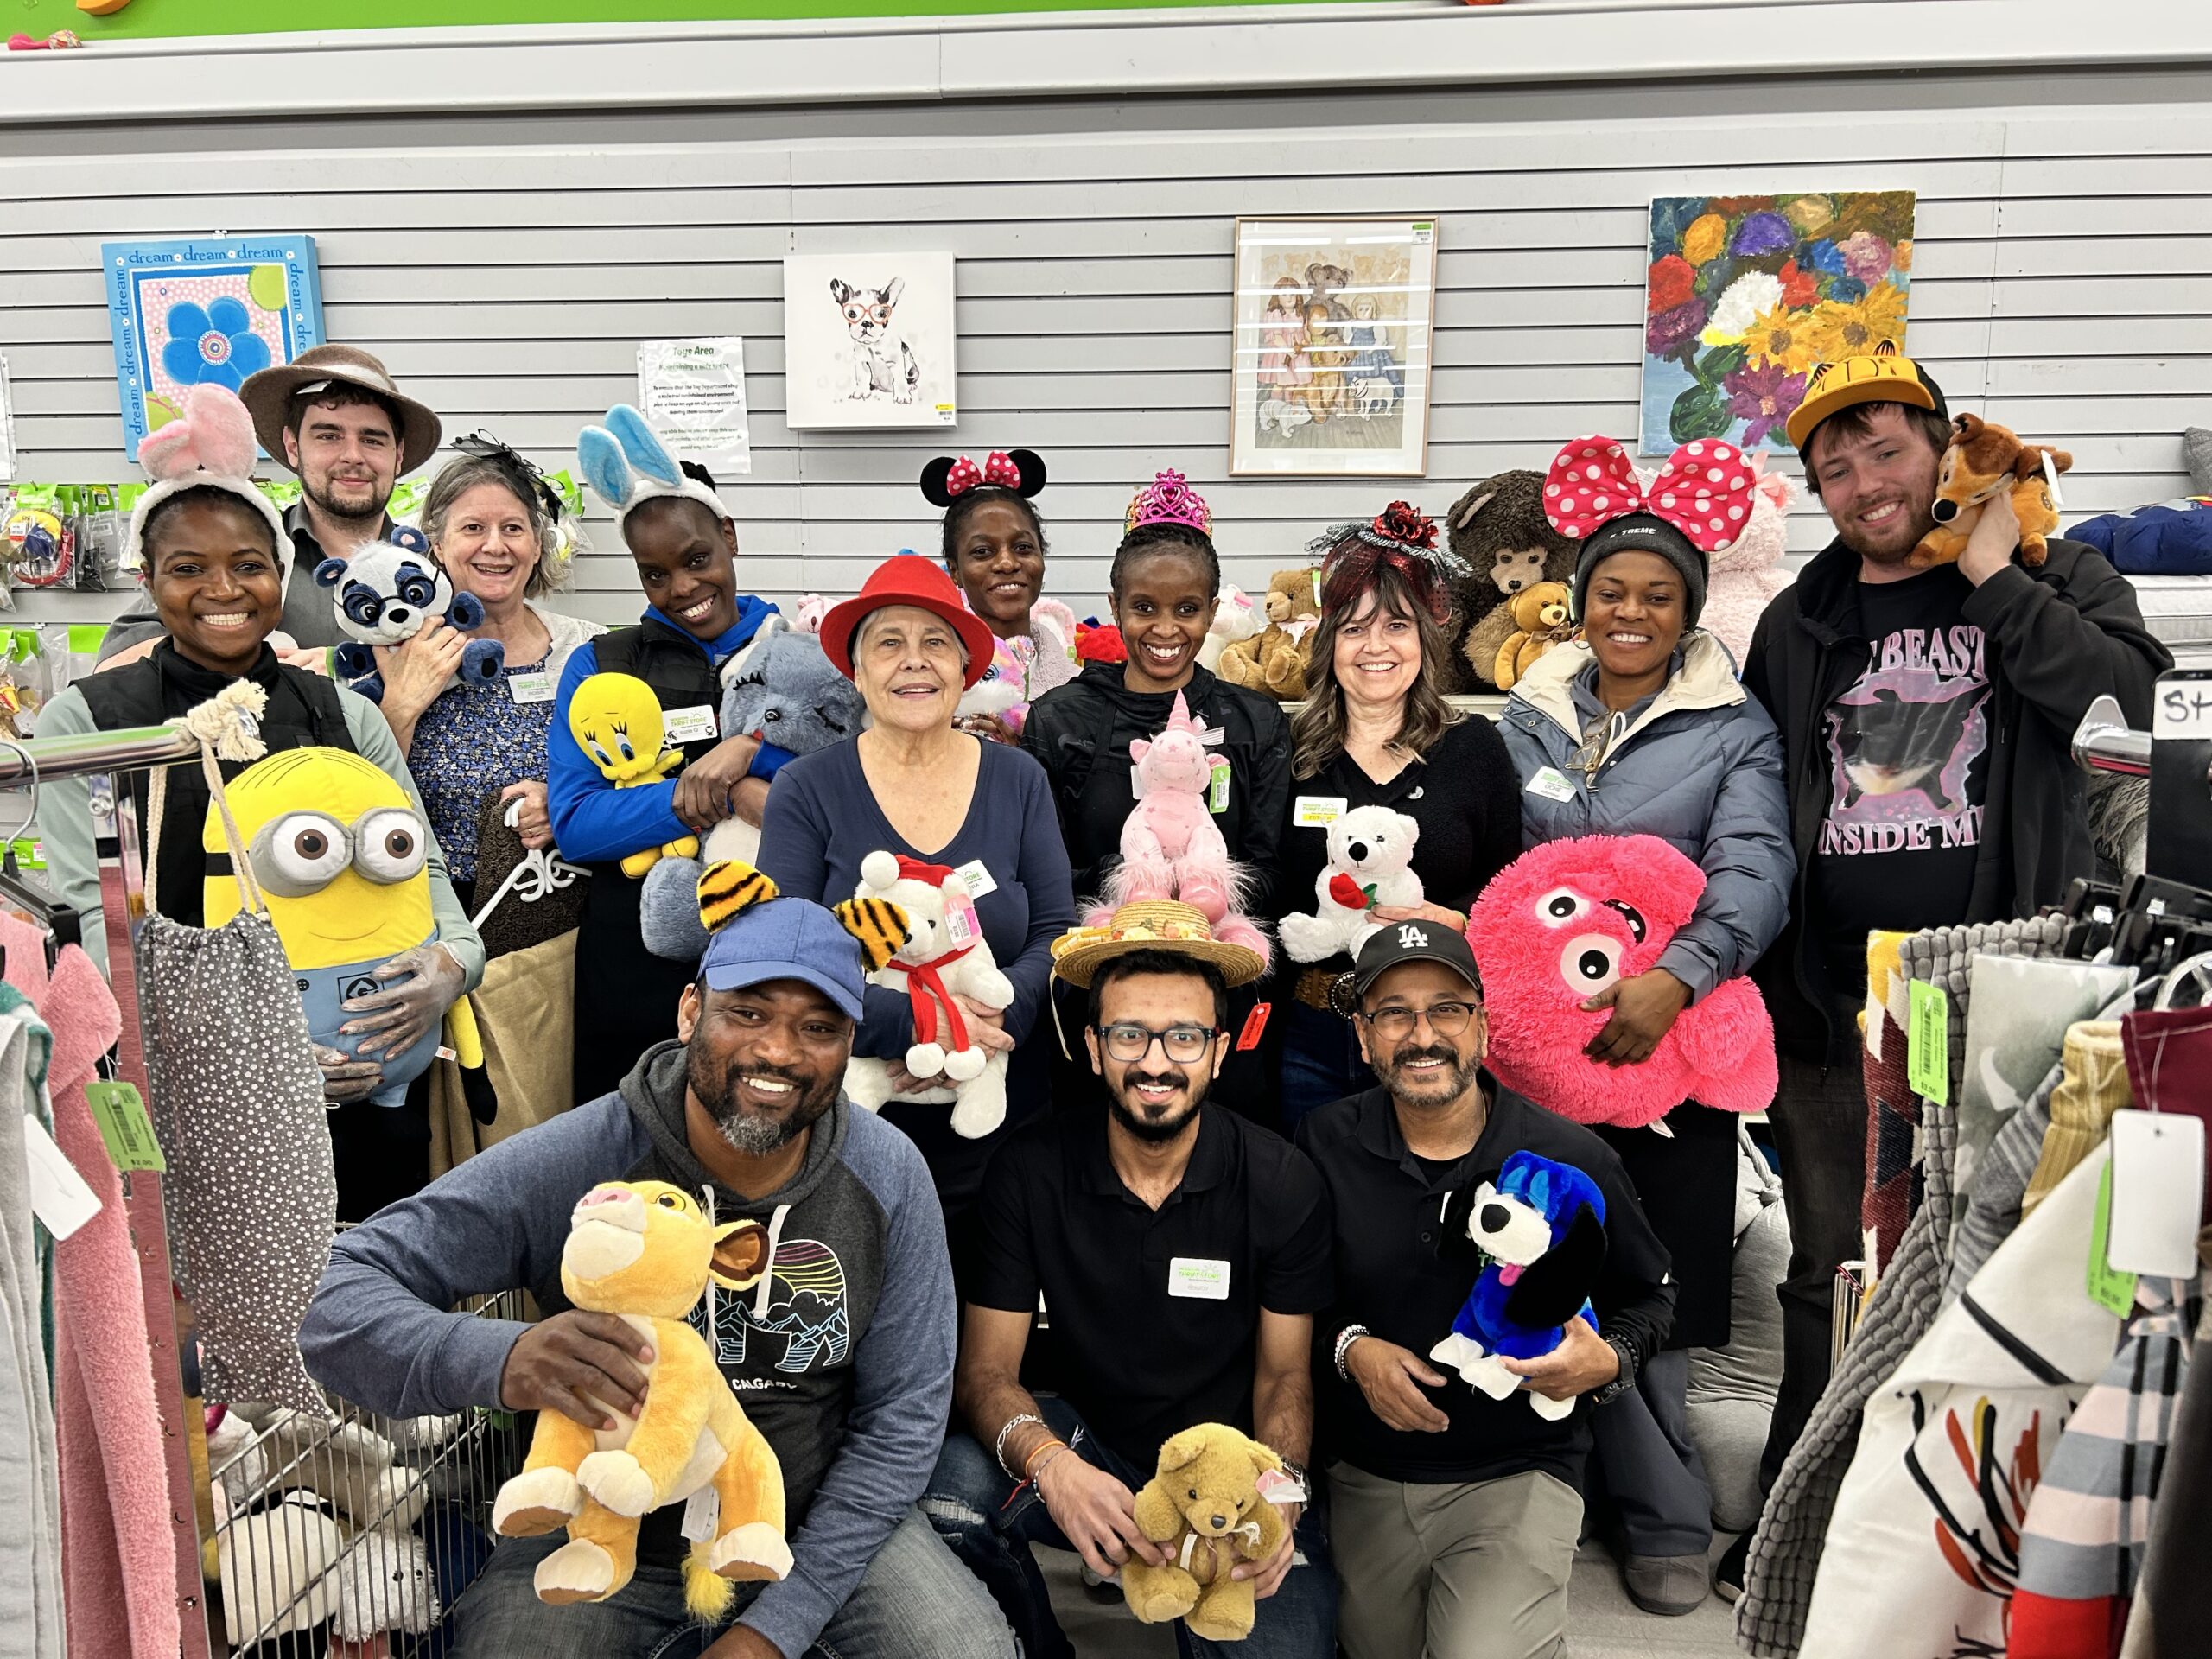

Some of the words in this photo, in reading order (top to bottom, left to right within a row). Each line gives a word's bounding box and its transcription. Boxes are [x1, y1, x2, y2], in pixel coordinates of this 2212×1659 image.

[128, 250, 174, 264] dream
[183, 245, 227, 262] dream
[237, 243, 284, 259] dream
[113, 268, 130, 316] dream
[289, 263, 304, 310] dream
[119, 329, 136, 375] dream
[673, 347, 693, 358] Toys
[694, 346, 715, 355] Area
[128, 389, 143, 435] dream
[1817, 817, 1931, 855] INSIDE
[1397, 925, 1429, 949] LA
